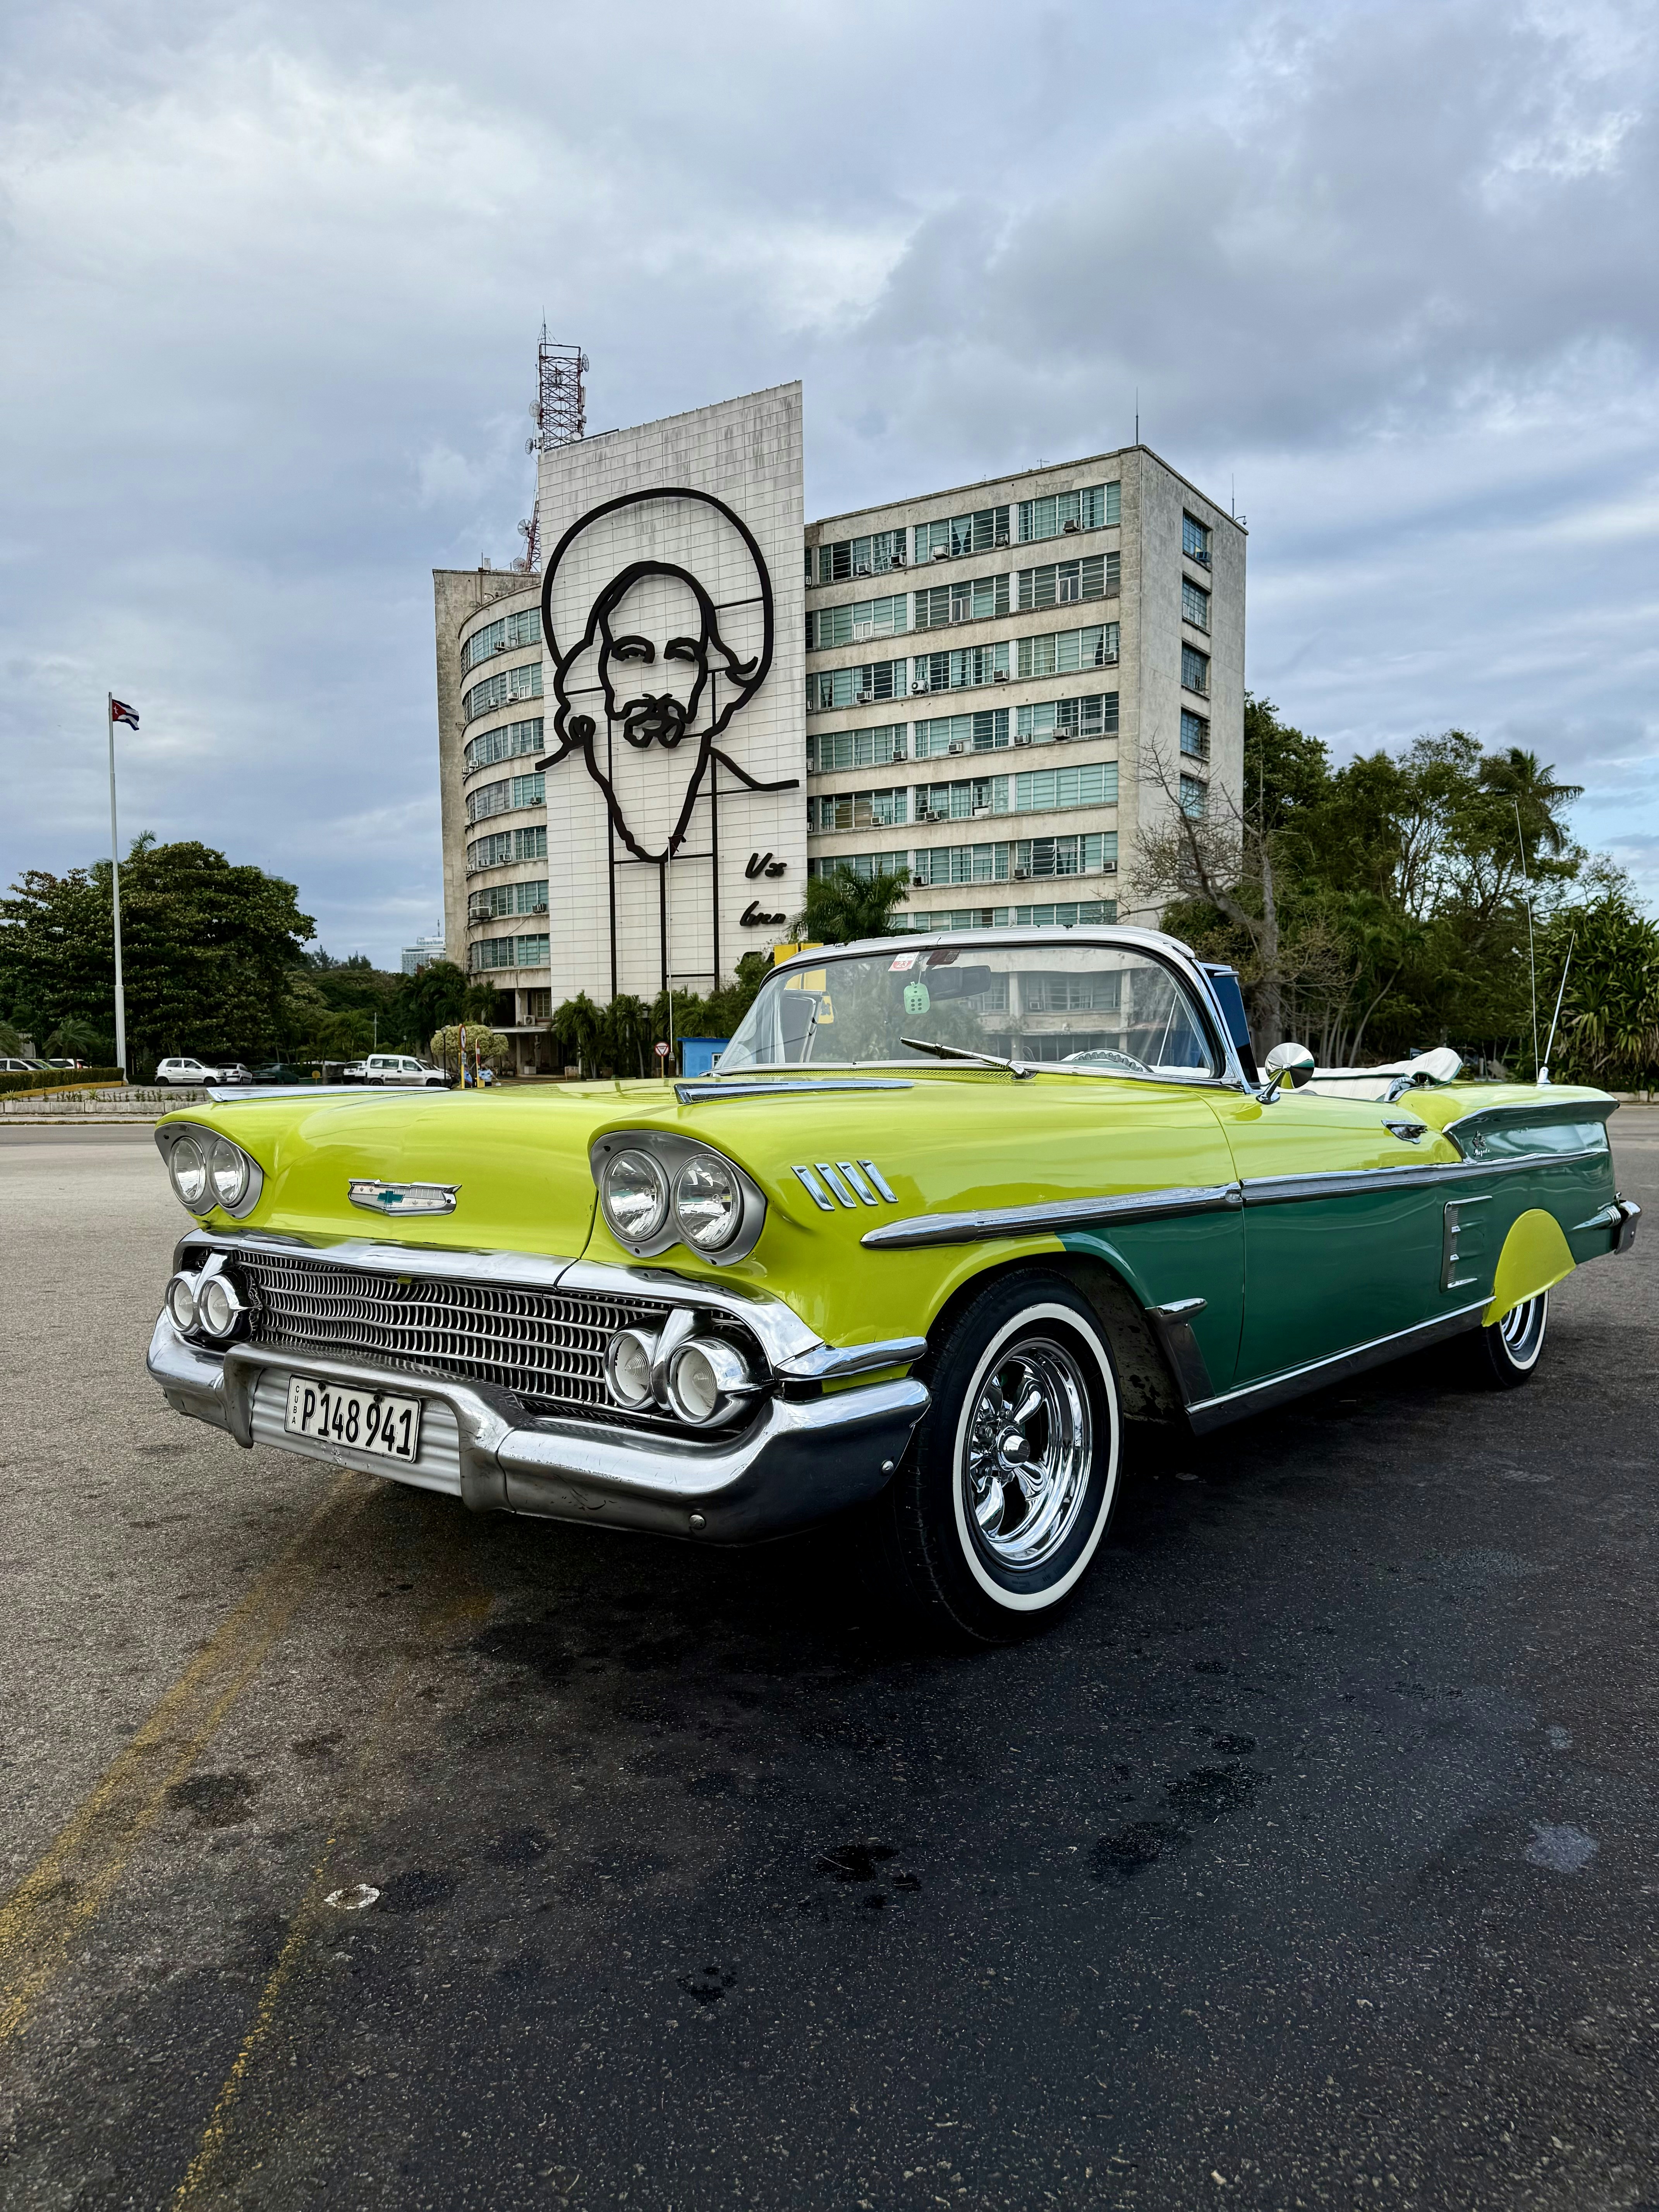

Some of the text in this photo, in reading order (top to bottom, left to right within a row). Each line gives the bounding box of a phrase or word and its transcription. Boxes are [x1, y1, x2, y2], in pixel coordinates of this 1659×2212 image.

[292, 1385, 300, 1424] CUBA
[301, 1389, 413, 1456] P148 941
